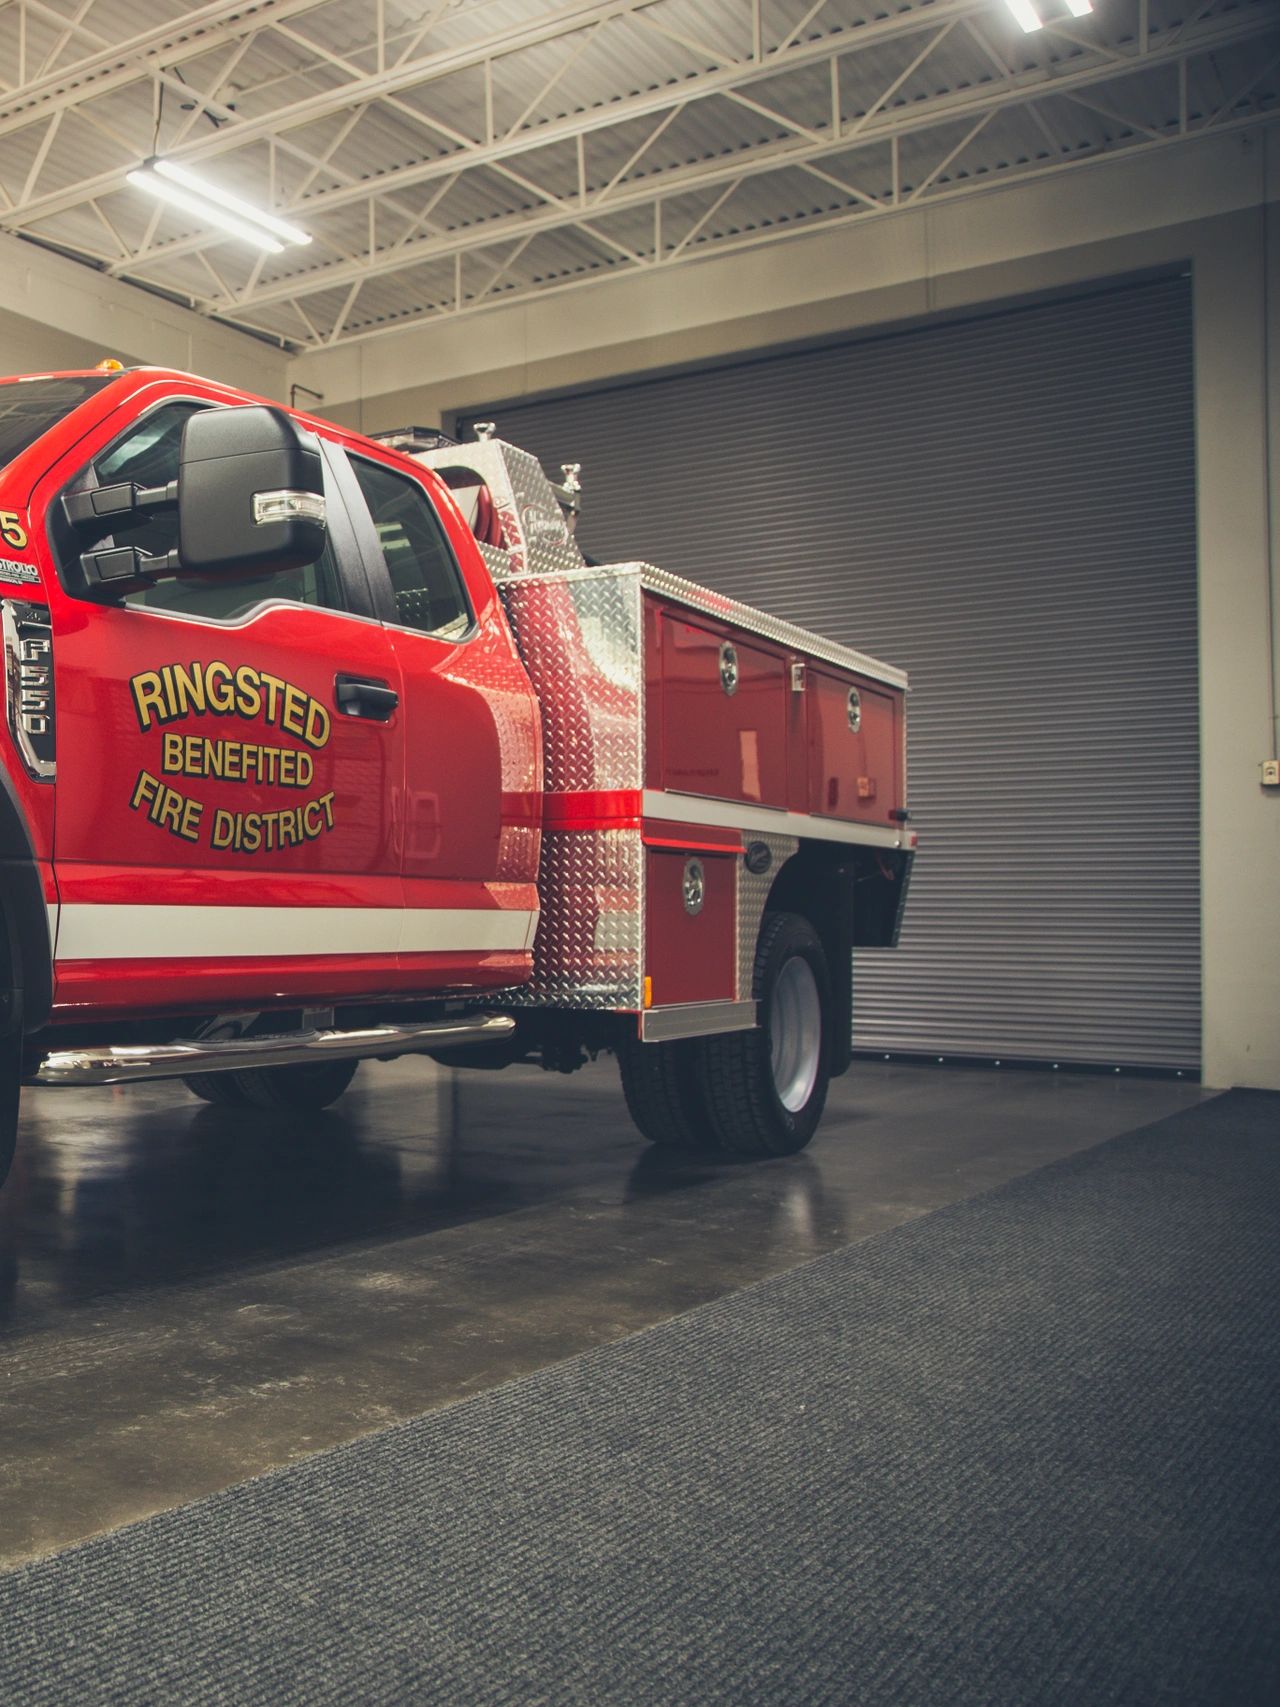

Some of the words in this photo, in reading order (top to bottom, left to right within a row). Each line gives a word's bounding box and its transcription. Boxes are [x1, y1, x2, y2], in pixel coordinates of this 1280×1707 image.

[130, 660, 331, 749] RINGSTED
[162, 733, 314, 789] BENEFITED
[129, 769, 204, 844] FIRE
[210, 791, 336, 853] DISTRICT
